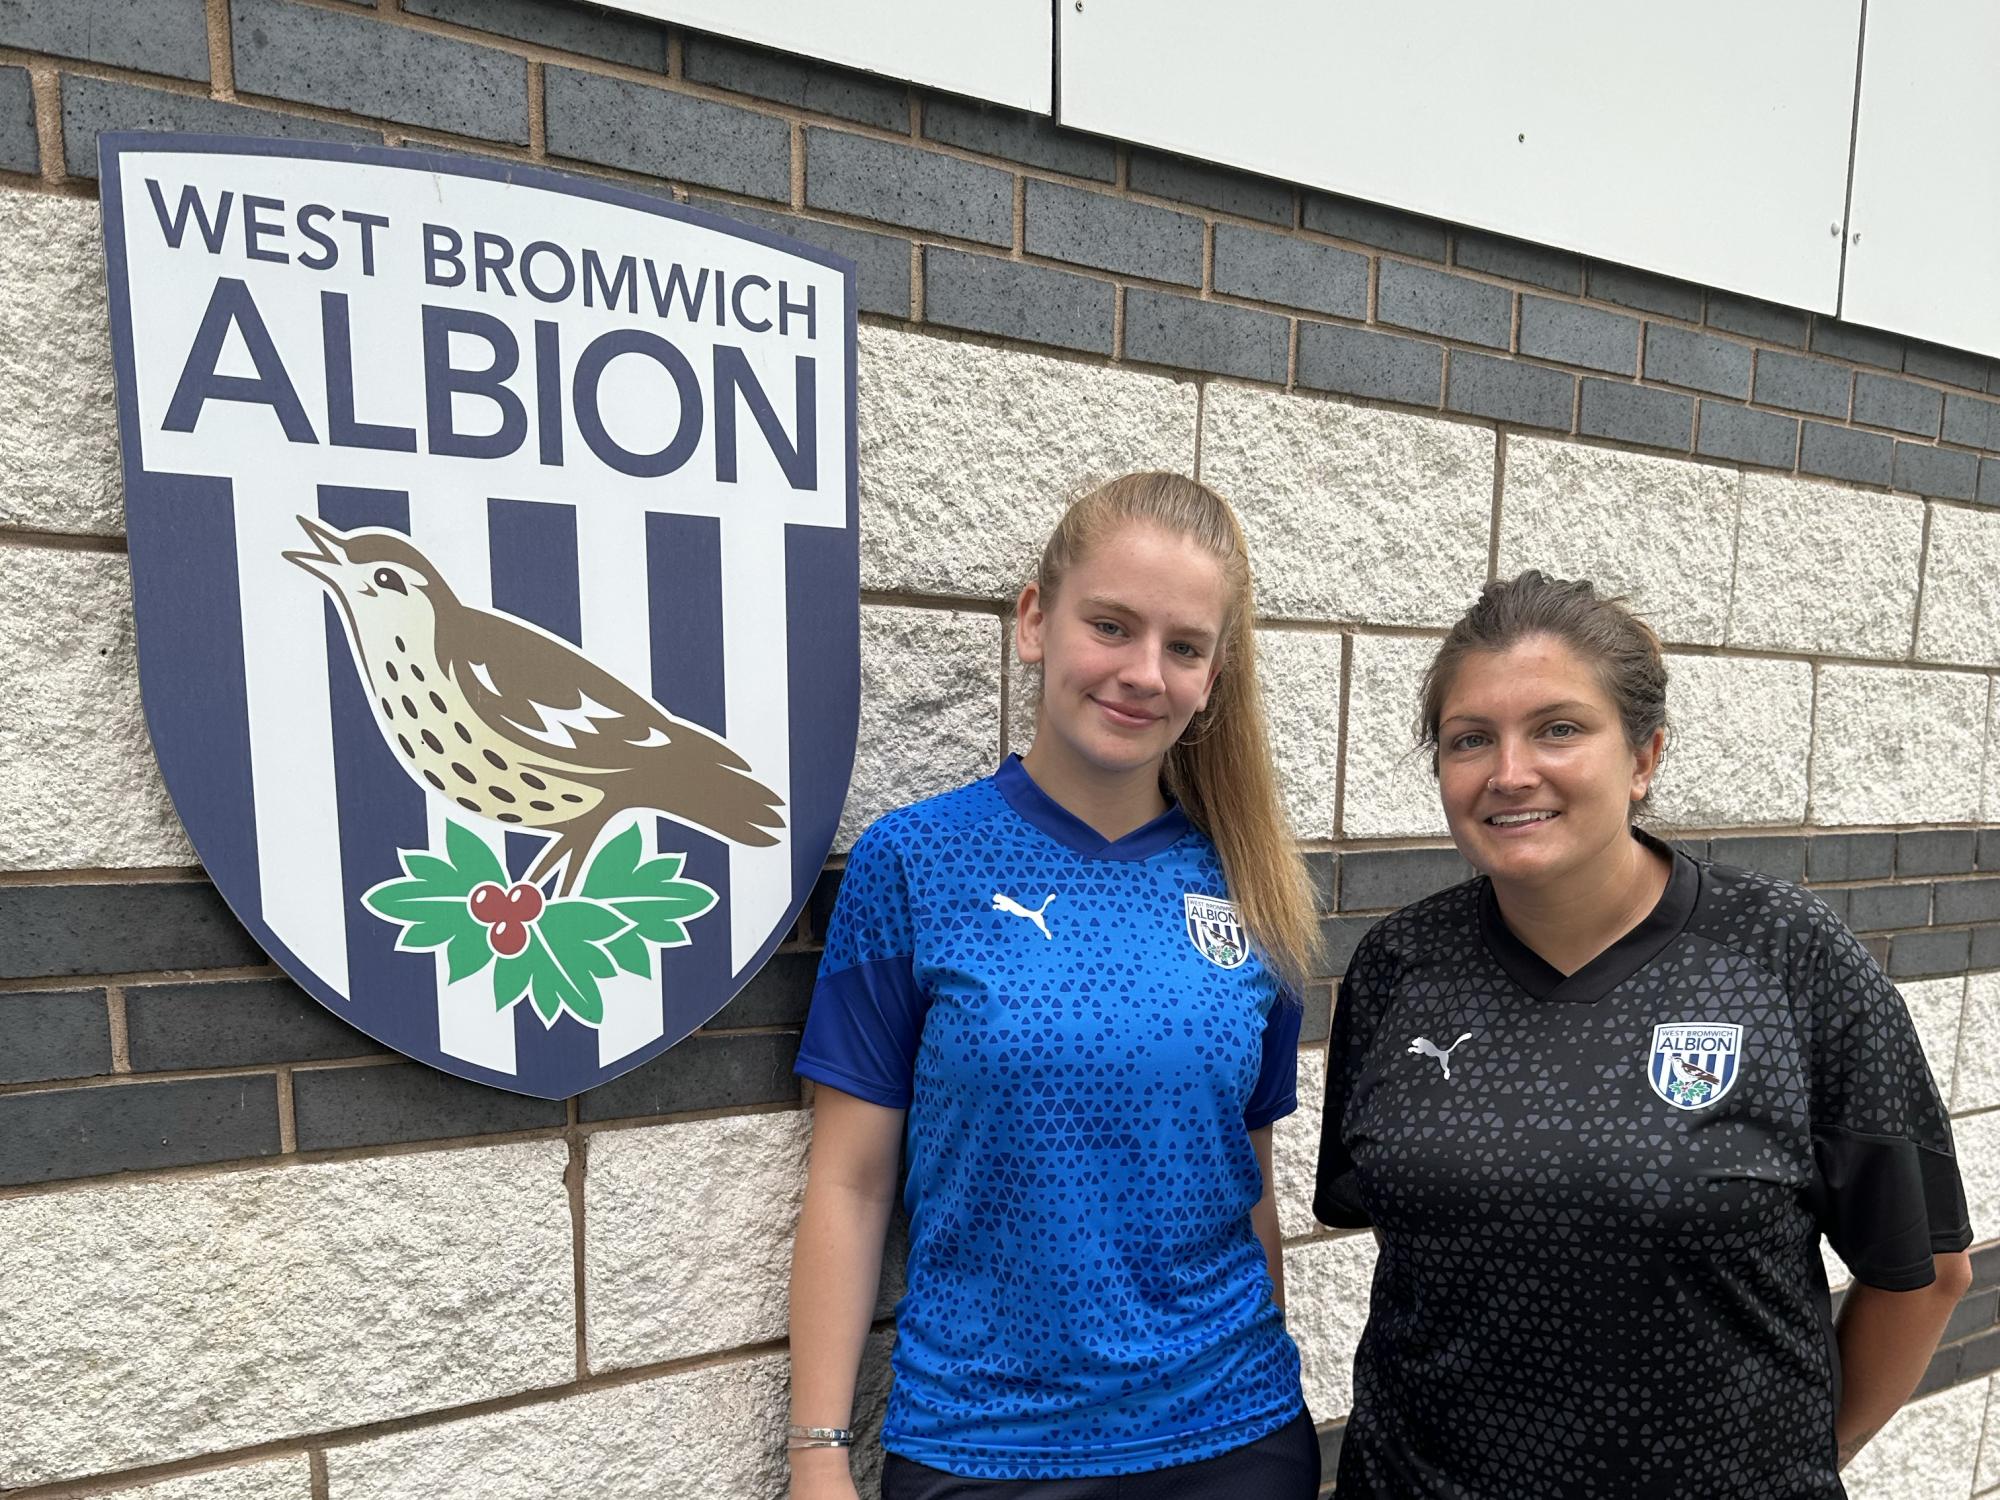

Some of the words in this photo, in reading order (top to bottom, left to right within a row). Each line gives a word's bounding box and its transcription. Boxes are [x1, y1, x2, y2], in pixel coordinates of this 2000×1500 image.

[145, 178, 389, 276] WEST
[422, 223, 817, 340] BROMWICH
[161, 277, 818, 491] ALBION
[1191, 906, 1239, 925] ALBION
[1660, 1037, 1732, 1051] ALBION
